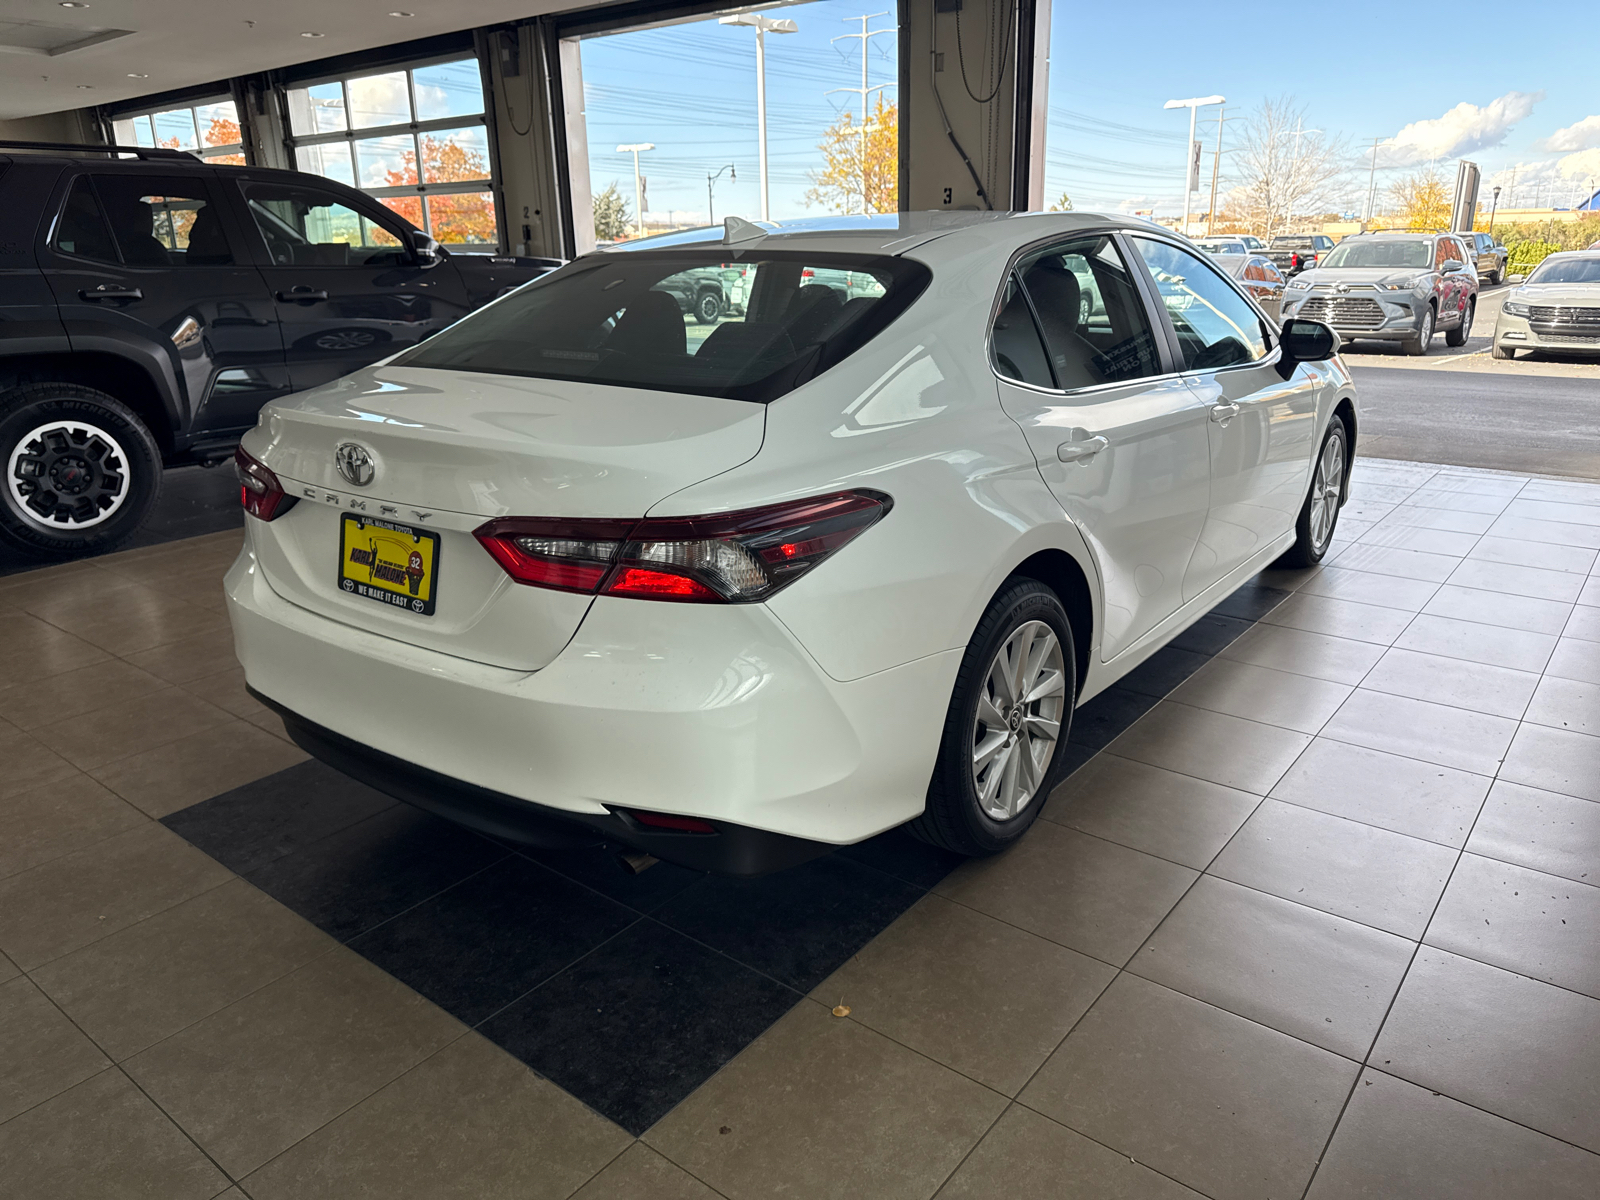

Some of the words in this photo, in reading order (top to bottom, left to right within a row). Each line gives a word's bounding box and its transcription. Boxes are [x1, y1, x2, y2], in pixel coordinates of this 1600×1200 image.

[943, 187, 952, 205] 3
[523, 206, 530, 219] 2
[62, 401, 129, 427] MICHELIN
[303, 487, 433, 522] CAMRY
[361, 517, 374, 526] KARL
[374, 520, 394, 531] MALONE
[395, 524, 413, 535] TOYOTA
[350, 547, 372, 567] KARL
[410, 556, 421, 570] 32
[374, 563, 407, 587] MALONE
[358, 584, 368, 596] WE
[368, 587, 384, 601] MAKE
[385, 592, 392, 602] IT
[392, 594, 408, 607] EASY
